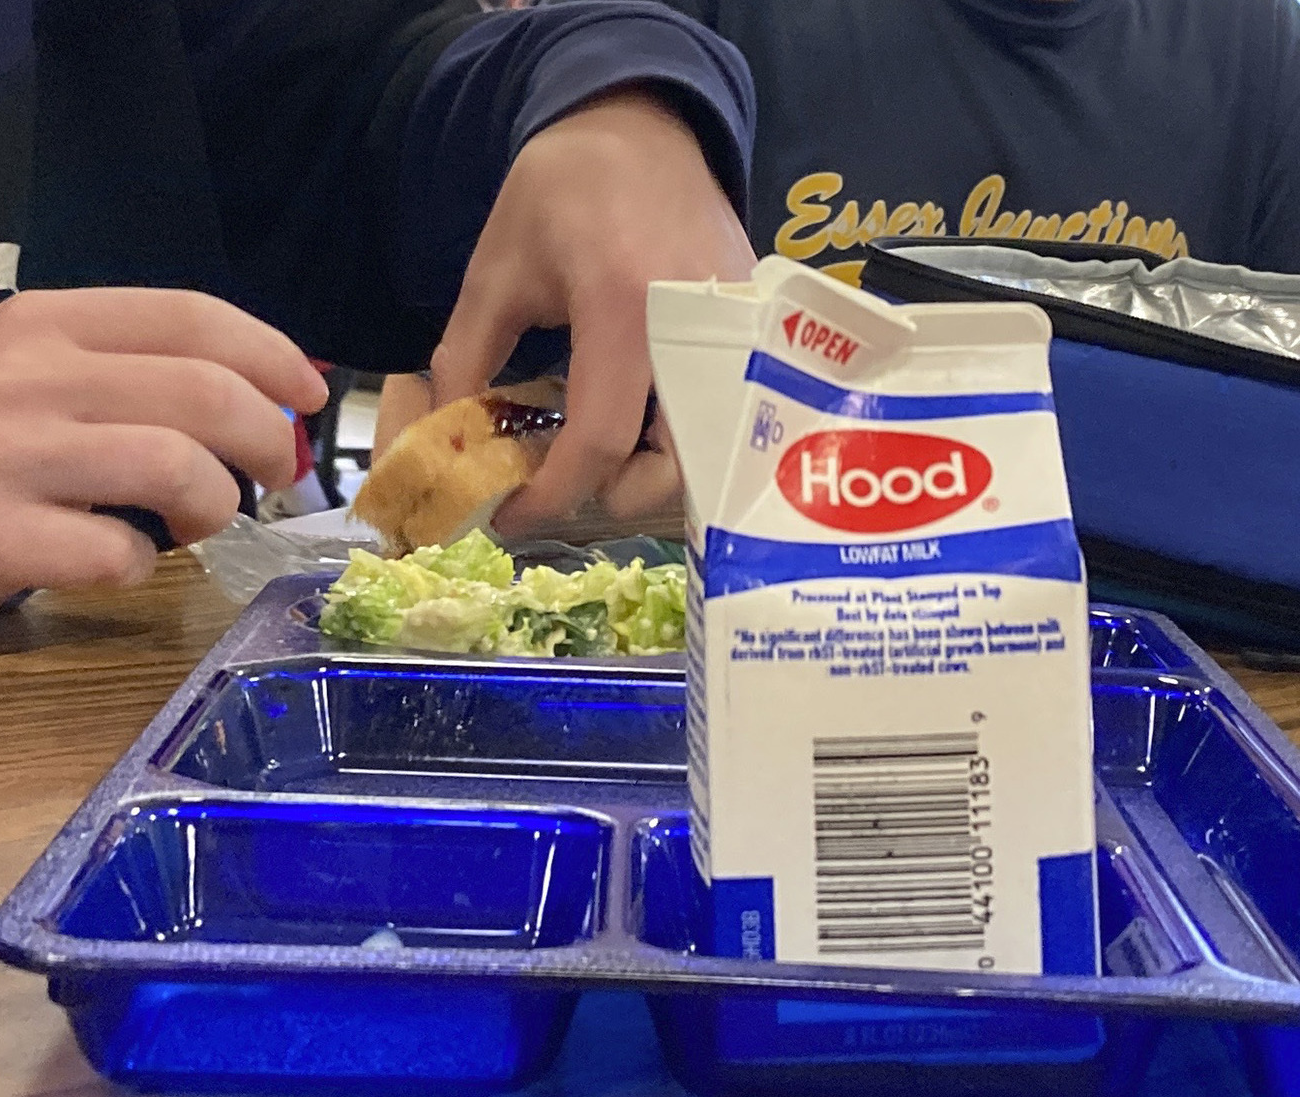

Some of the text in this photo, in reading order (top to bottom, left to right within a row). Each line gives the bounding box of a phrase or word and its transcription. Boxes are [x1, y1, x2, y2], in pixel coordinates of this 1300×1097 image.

[774, 172, 1190, 261] Essex Junction
[801, 320, 859, 366] OPEN
[800, 450, 967, 507] Hood
[840, 539, 941, 564] LOWFAT MILK
[791, 582, 1002, 603] Processed at Plant Stamped on Top
[837, 605, 960, 624] Best by date stamped
[759, 627, 822, 647] significant
[825, 628, 884, 642] difference
[889, 627, 909, 641] has
[913, 625, 941, 640] been
[945, 623, 983, 638] shown
[985, 621, 1034, 636] between
[1037, 618, 1060, 634] milk
[731, 646, 774, 661] derived
[778, 647, 805, 660] from
[888, 642, 941, 659] (artificial
[946, 641, 985, 659] growth
[988, 637, 1042, 653] hormone)
[1046, 636, 1065, 650] and
[938, 661, 970, 674] cows.
[969, 710, 995, 970] 0 44100 11183 9
